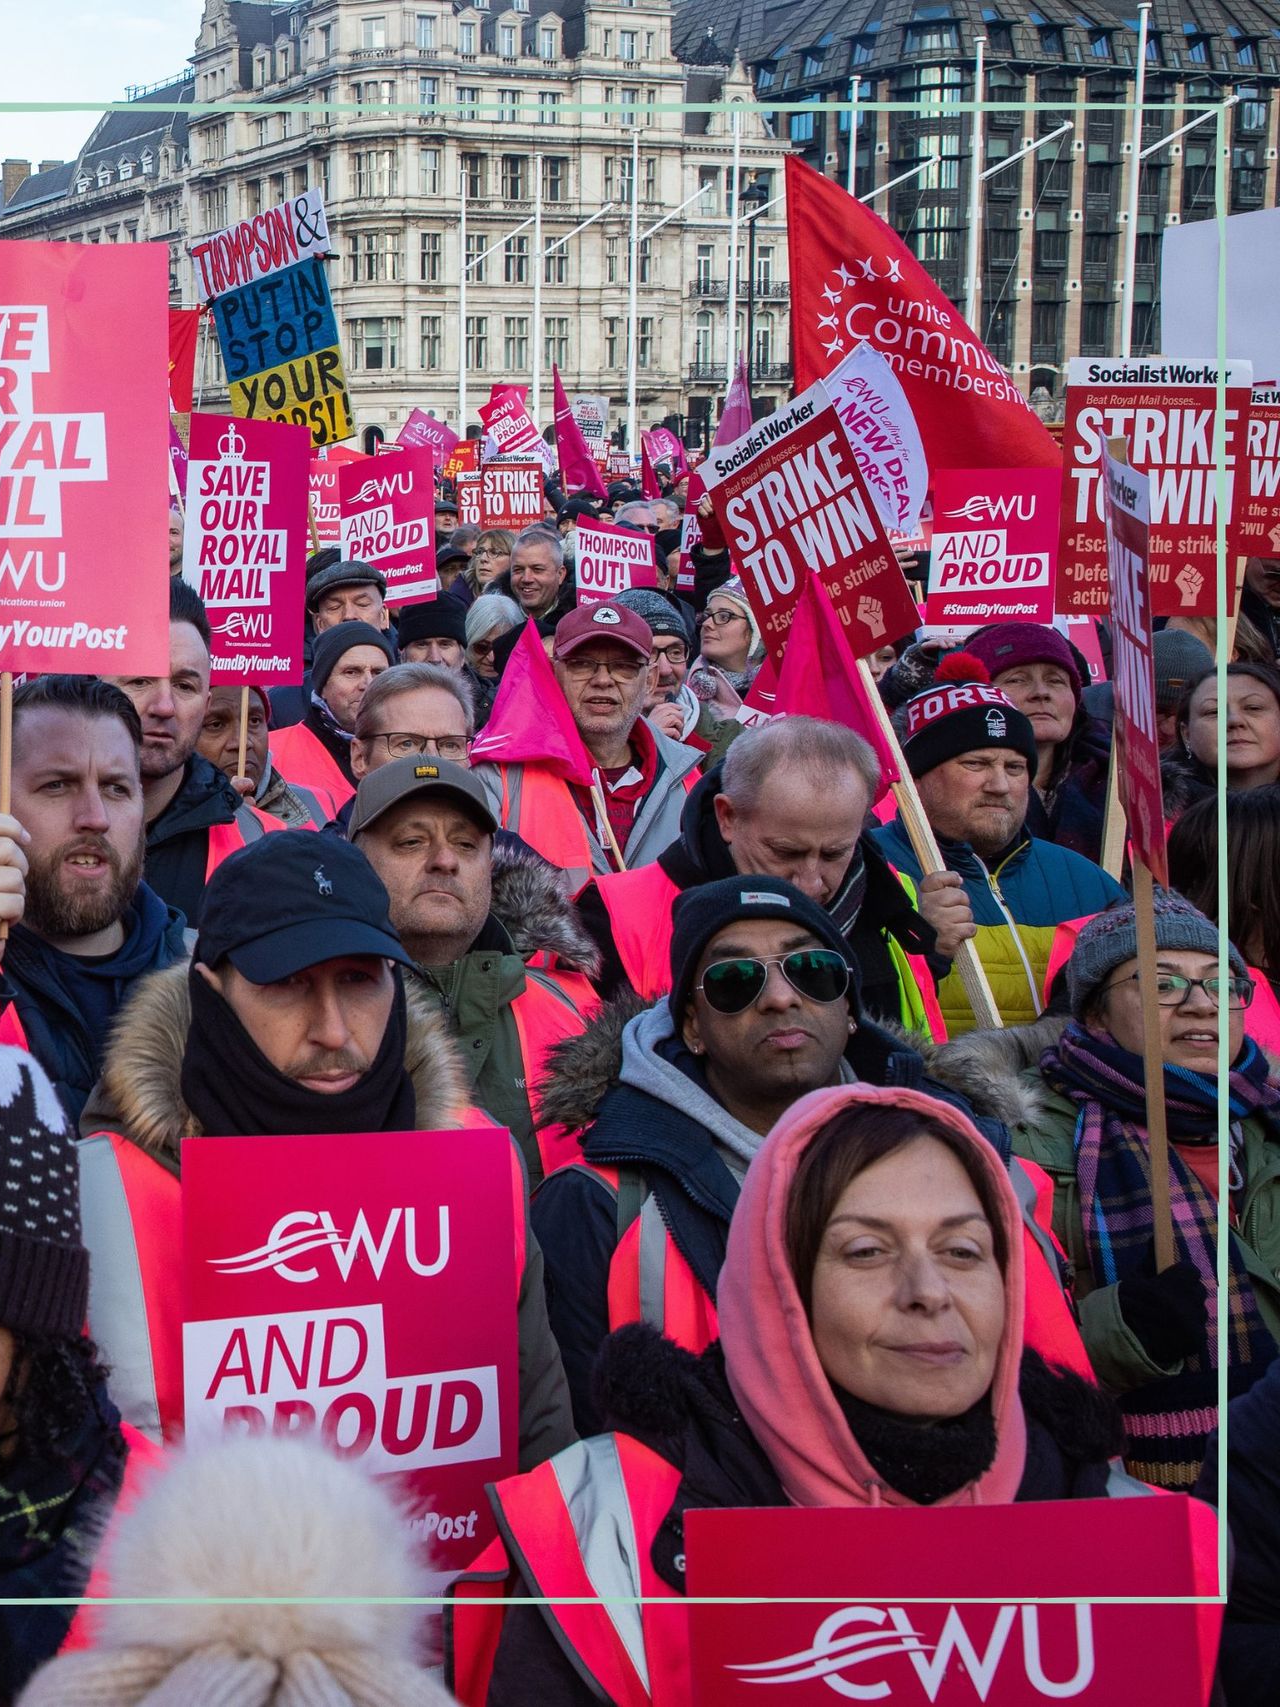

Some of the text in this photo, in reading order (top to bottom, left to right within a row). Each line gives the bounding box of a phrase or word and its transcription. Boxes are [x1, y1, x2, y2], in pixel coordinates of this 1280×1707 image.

[192, 202, 298, 297] THOMPSON
[221, 262, 326, 336] PUTIN
[888, 297, 951, 330] unite
[229, 310, 322, 377] STOP
[240, 350, 345, 419] YOUR
[1086, 394, 1108, 406] Beat
[1110, 394, 1136, 407] Royal
[1138, 395, 1161, 406] Mail
[493, 418, 512, 435] AND
[840, 377, 890, 415] CWU
[880, 416, 902, 445] calling
[409, 422, 444, 444] CWU
[497, 417, 527, 443] PROUD
[588, 440, 609, 450] TRIKE
[1074, 407, 1239, 465] STRIKE
[309, 474, 335, 487] WU
[839, 402, 895, 452] NEW
[884, 457, 910, 527] DEAL
[199, 465, 266, 497] SAVE
[347, 471, 414, 503] CWU
[484, 471, 539, 492] STRIKE
[725, 482, 741, 498] Beat
[726, 430, 854, 552] STRIKE
[484, 494, 504, 515] TO
[510, 493, 540, 515] WIN
[942, 495, 1036, 522] CWU
[1148, 469, 1235, 526] WIN
[1248, 503, 1267, 517] the
[200, 500, 258, 531] OUR
[346, 509, 389, 541] AND
[198, 534, 282, 566] ROYAL
[348, 523, 423, 562] PROUD
[579, 532, 648, 561] THOMPSON
[742, 547, 797, 607] TO
[789, 487, 878, 574] WIN
[939, 532, 1001, 562] AND
[1148, 536, 1229, 554] the strike
[200, 568, 265, 601] MAIL
[580, 556, 625, 590] OUT!
[823, 555, 888, 598] he strikes
[940, 557, 1043, 587] PROUD
[1074, 563, 1170, 583] Defe WU
[40, 599, 65, 608] union
[942, 602, 1038, 617] #StandByYourPost
[211, 612, 272, 638] CWU
[210, 654, 291, 676] StandByYourPost
[205, 1205, 450, 1284] CWU
[205, 1317, 369, 1400] AND
[723, 1603, 1095, 1704] CWU
